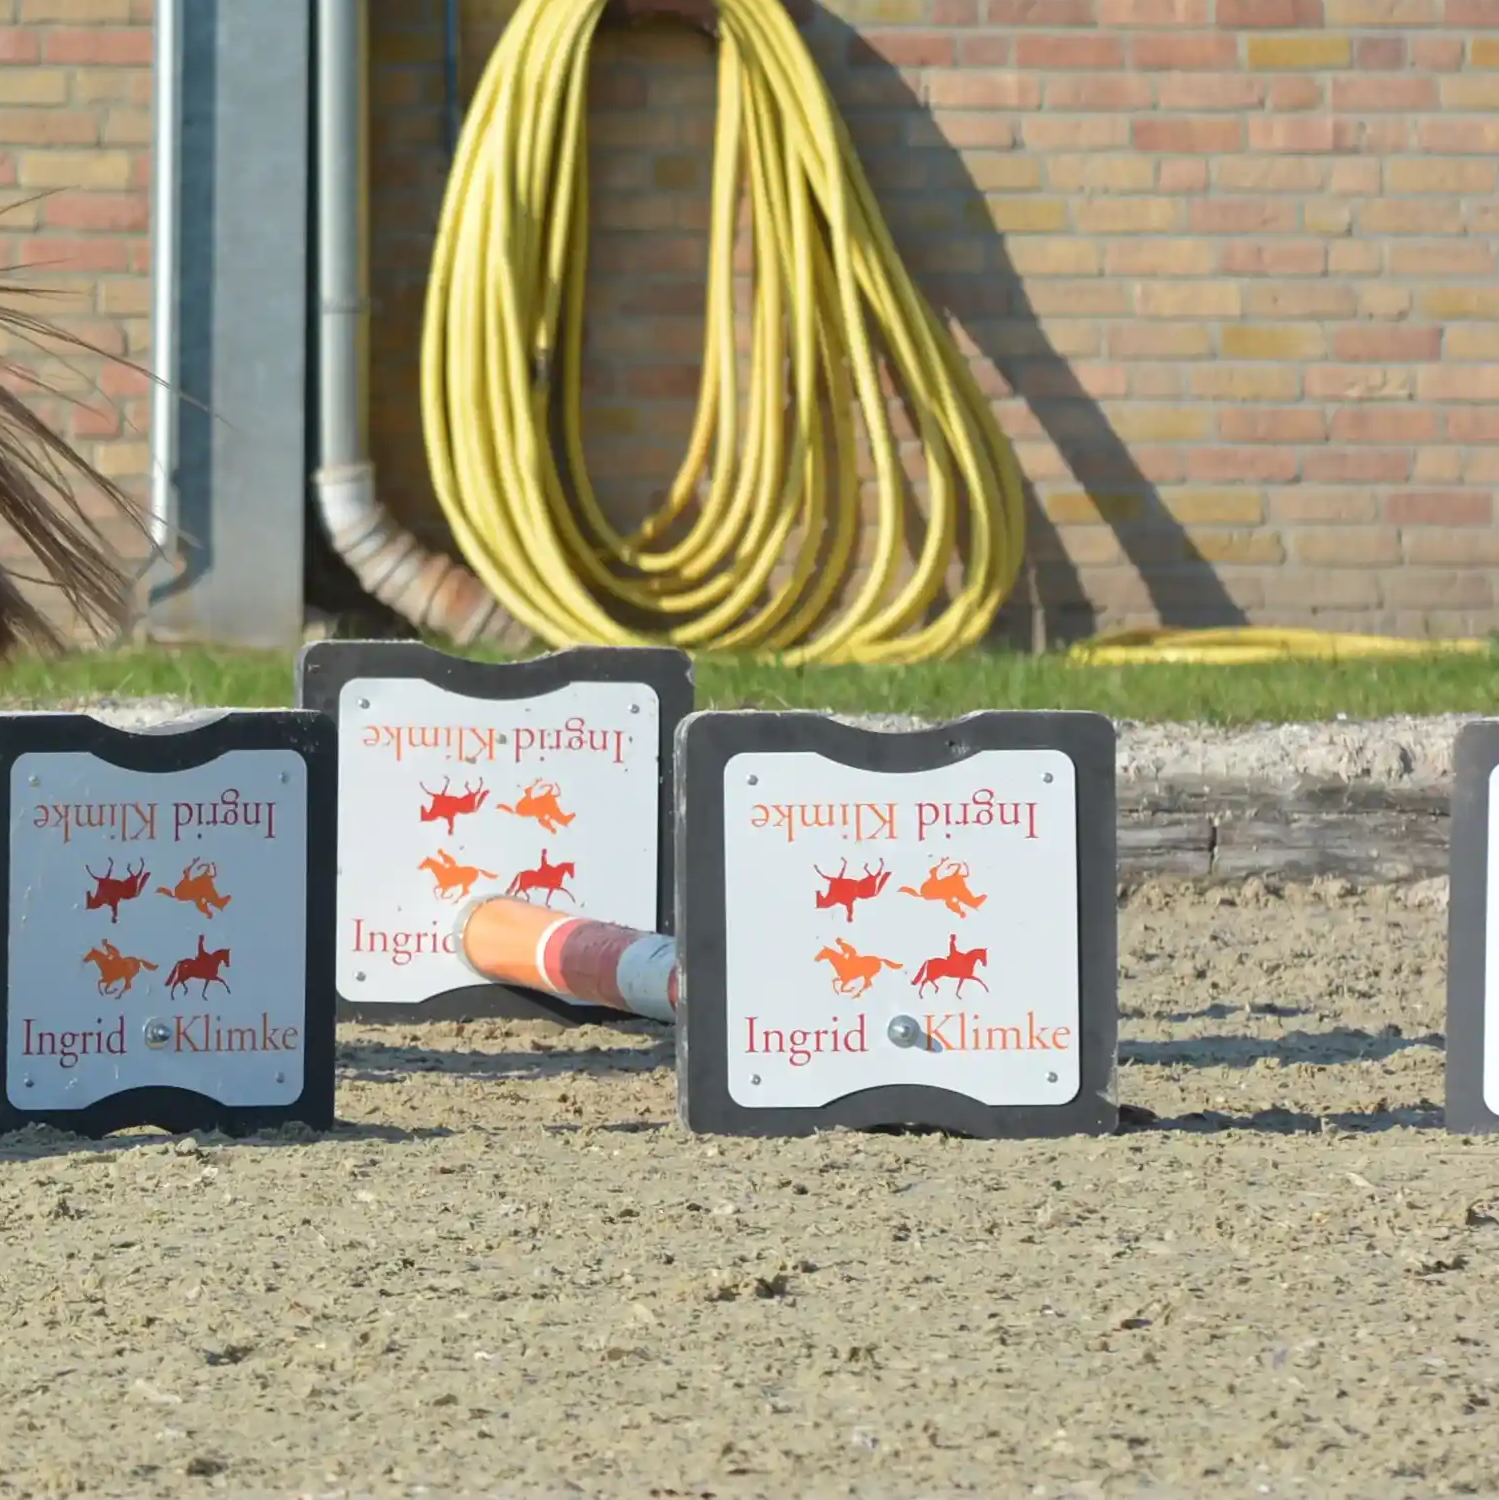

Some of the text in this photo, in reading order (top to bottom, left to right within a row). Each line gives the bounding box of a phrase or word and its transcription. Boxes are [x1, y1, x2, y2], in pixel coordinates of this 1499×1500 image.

[362, 717, 624, 764] Ingrid Klimke
[33, 789, 277, 843] Ingrid Klimke
[750, 789, 1038, 842] Ingrid Klimke
[22, 1013, 299, 1068] Ingrid Klimke
[744, 1012, 1071, 1066] Ingrid Klimke
